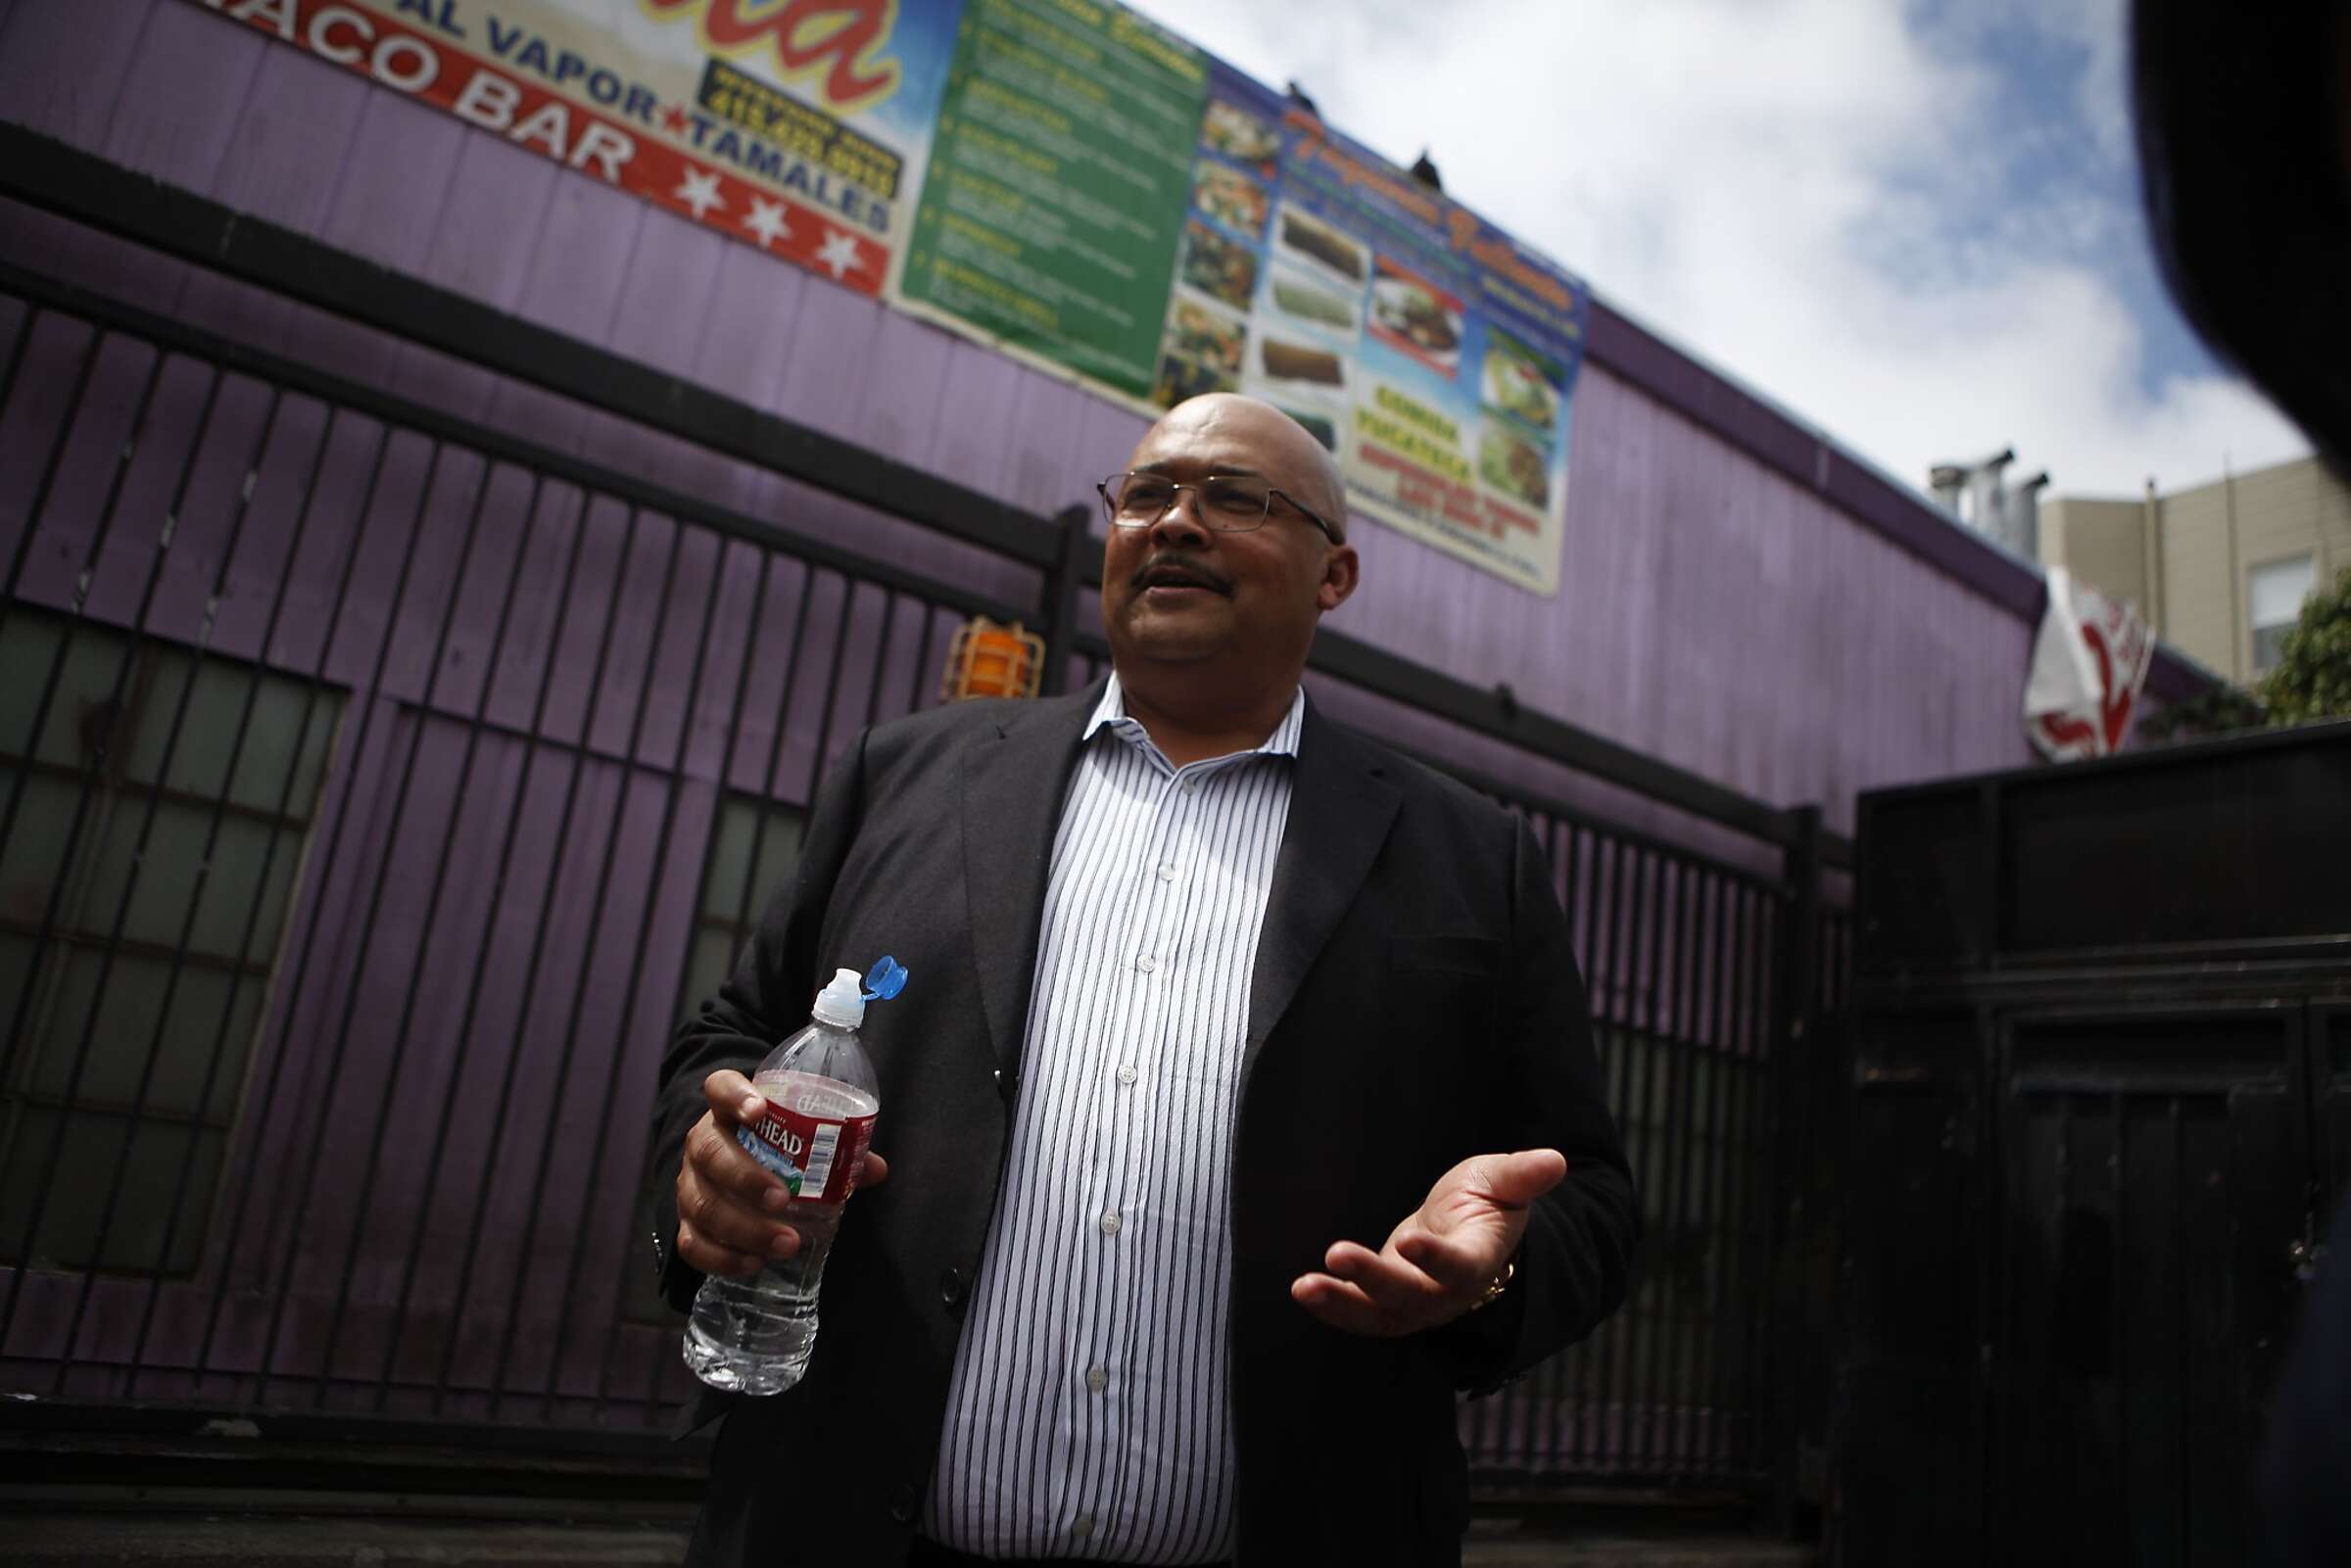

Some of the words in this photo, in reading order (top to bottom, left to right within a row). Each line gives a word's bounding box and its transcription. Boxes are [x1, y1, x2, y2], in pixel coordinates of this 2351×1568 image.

[199, 0, 439, 93] ACO
[454, 69, 637, 184] BAR
[487, 15, 658, 126] VAPOR
[691, 110, 890, 233] TAMALES
[755, 1116, 802, 1156] HEAD
